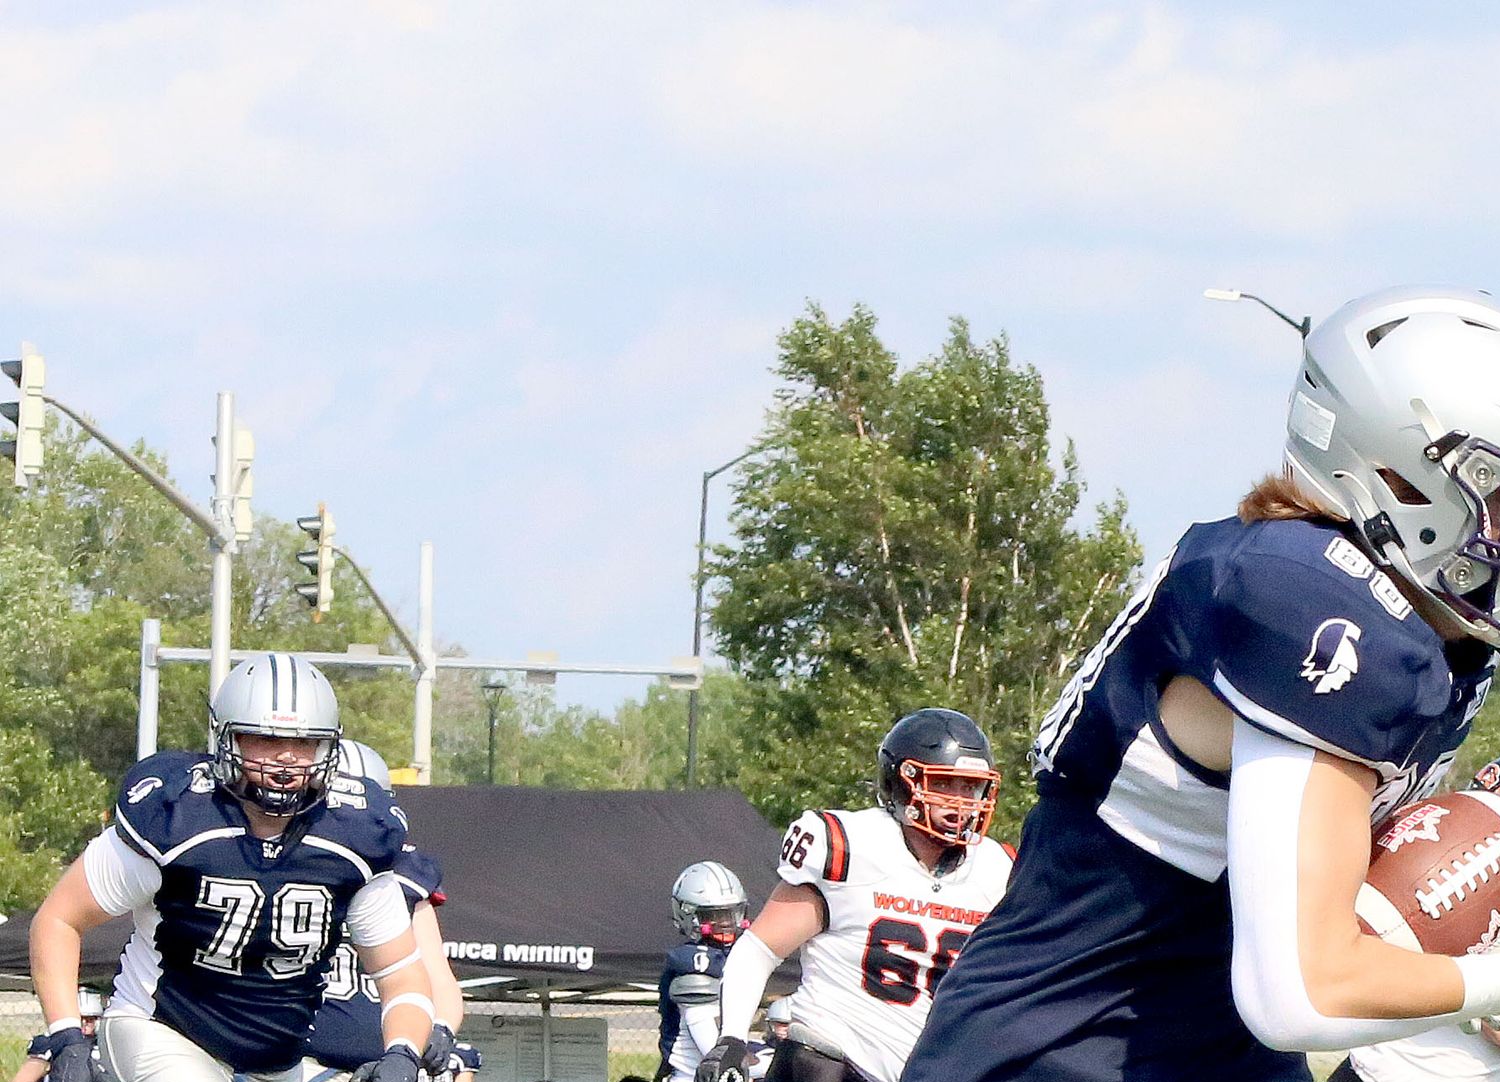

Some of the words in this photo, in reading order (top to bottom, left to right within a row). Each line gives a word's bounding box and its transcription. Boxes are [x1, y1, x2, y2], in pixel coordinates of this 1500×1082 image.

[781, 825, 815, 869] 66
[193, 875, 334, 980] 79
[503, 944, 595, 971] Mining
